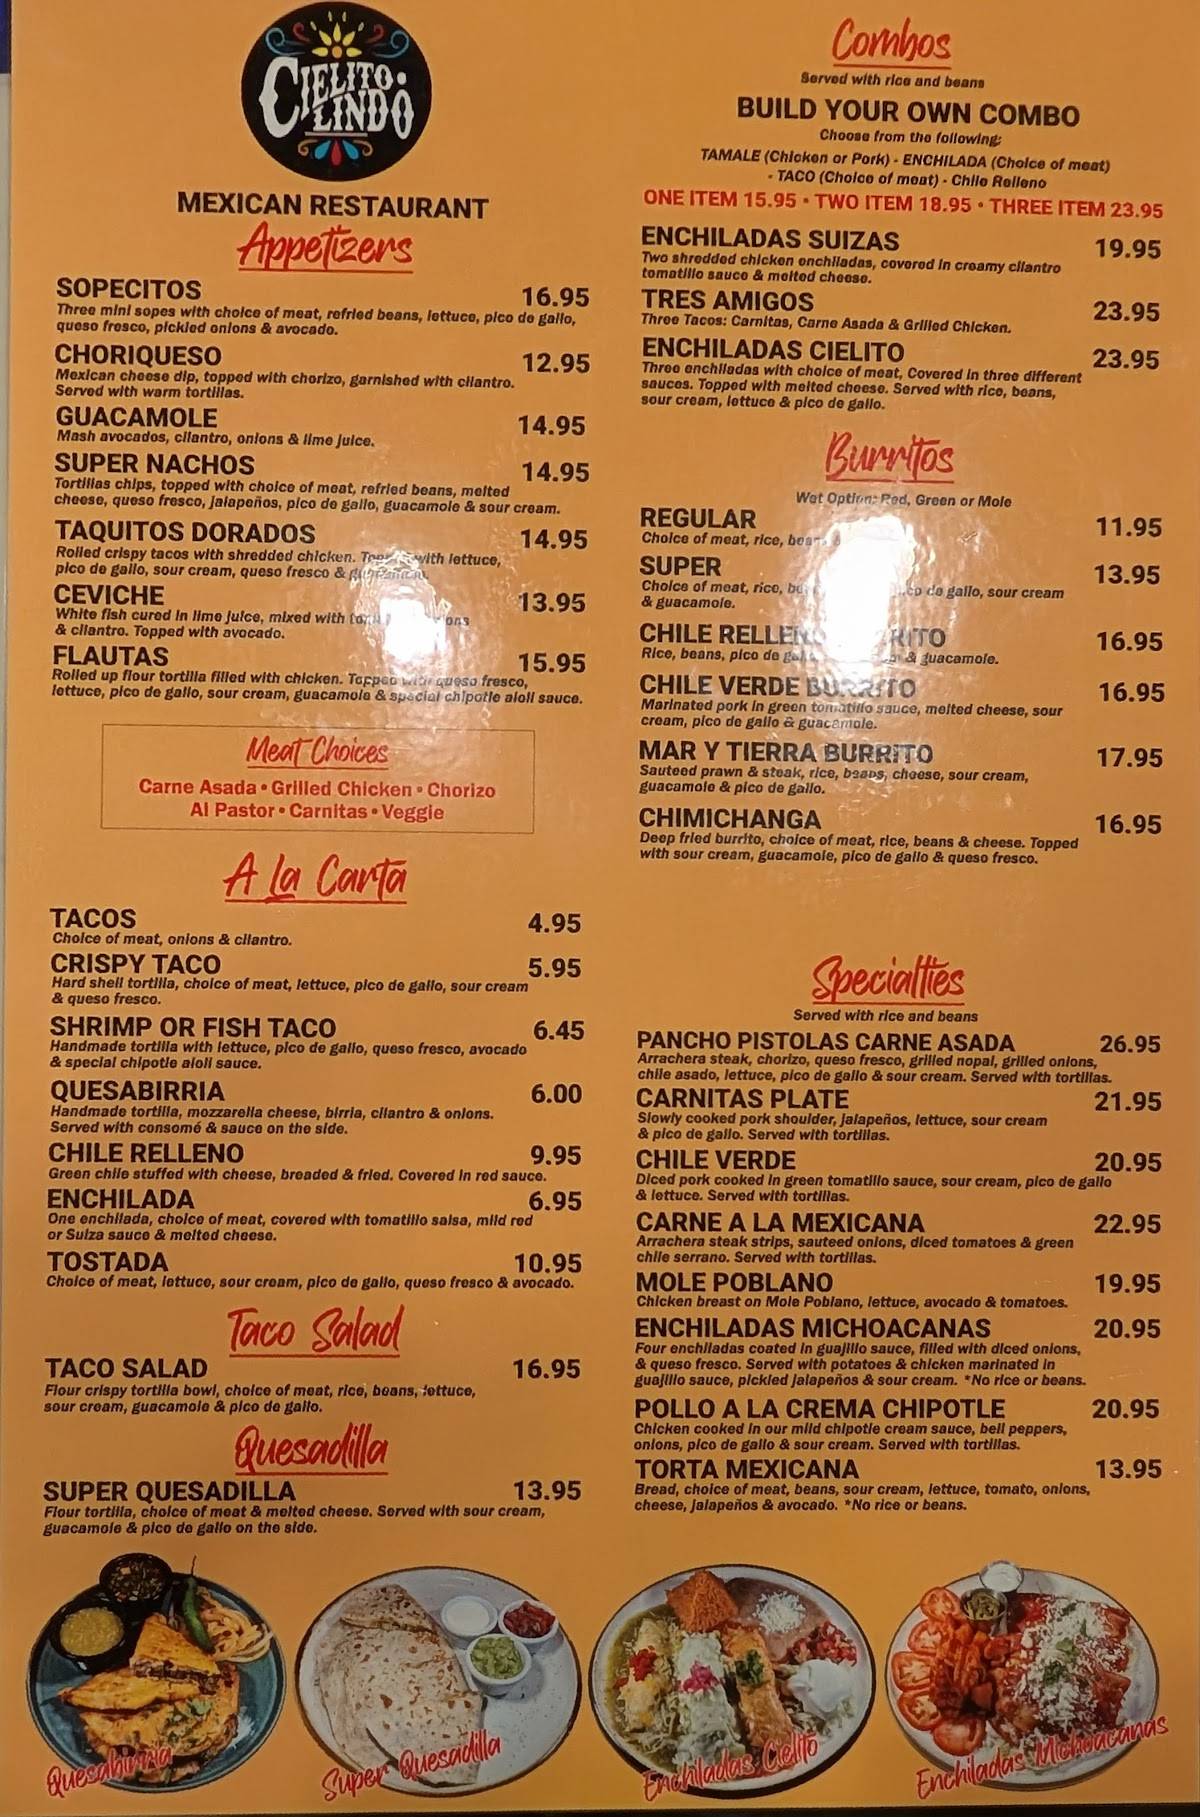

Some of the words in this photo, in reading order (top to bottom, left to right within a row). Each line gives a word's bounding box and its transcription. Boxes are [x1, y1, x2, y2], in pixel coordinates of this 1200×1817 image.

[832, 17, 950, 61] Combos
[258, 57, 394, 138] CIELITO
[312, 88, 414, 140] LINDO
[738, 96, 816, 119] BUILD
[825, 98, 898, 122] YOUR
[908, 101, 970, 124] OWN
[980, 103, 1079, 127] COMBO
[178, 191, 301, 215] MEXICAN
[311, 194, 489, 219] RESTAURANT
[644, 189, 684, 205] ONE
[690, 190, 737, 207] ITEM
[744, 191, 796, 208] 15.95
[815, 193, 858, 209] TWO
[866, 194, 912, 211] ITEM
[920, 196, 971, 213] 18.95
[990, 198, 1053, 215] THREE
[1059, 199, 1105, 217] ITEM
[1111, 201, 1163, 218] 23.95
[237, 220, 412, 270] Appetizers
[642, 225, 801, 249] ENCHILADAS
[809, 229, 899, 251] SUIZAS
[1096, 238, 1160, 259] 19.95
[57, 277, 201, 300] SOPECITOS
[523, 286, 589, 307] 16.95
[642, 288, 705, 309] TRES
[713, 290, 813, 312] AMIGOS
[642, 312, 679, 325] Three
[684, 313, 726, 326] Tacos:
[732, 314, 792, 329] Carnitas,
[798, 316, 838, 328] Carne
[842, 317, 883, 330] Asada
[888, 318, 899, 330] &
[904, 318, 949, 331] Grilled
[953, 320, 1011, 334] Chicken.
[55, 343, 221, 368] CHORIQUESO
[643, 336, 802, 360] ENCHILADAS
[810, 340, 904, 363] CIELITO
[55, 384, 104, 397] Served
[108, 384, 137, 397] with
[143, 388, 180, 397] warm
[186, 386, 243, 399] tortillas.
[57, 405, 217, 428] GUACAMOLE
[55, 452, 138, 473] SUPER
[147, 453, 254, 475] NACHOS
[826, 432, 953, 479] Burritos
[641, 507, 756, 529] REGULAR
[1097, 516, 1161, 538] 11.95
[55, 519, 184, 543] TAQUITOS
[192, 521, 315, 544] DORADOS
[640, 555, 721, 576] SUPER
[54, 584, 164, 606] CEVICHE
[55, 623, 66, 635] &
[71, 623, 128, 636] cilantro.
[134, 624, 184, 639] Topped
[189, 625, 218, 638] with
[223, 627, 284, 639] avocado.
[54, 645, 168, 666] FLAUTAS
[247, 736, 312, 767] Meat
[311, 735, 388, 765] Choices
[1098, 747, 1162, 768] 17.95
[139, 778, 193, 794] Carne
[200, 779, 256, 795] Asada
[272, 780, 331, 796] Grilled
[338, 780, 411, 797] Chicken
[428, 781, 495, 798] Chorizo
[191, 801, 208, 817] Al
[216, 802, 274, 818] Pastor
[290, 802, 367, 819] Carnitas
[382, 803, 444, 823] Veggie
[640, 807, 821, 830] CHIMICHANGA
[223, 852, 258, 896] A
[264, 853, 301, 903] La
[316, 854, 408, 901] Carta
[50, 908, 136, 928] TACOS
[529, 913, 580, 933] 4.95
[51, 953, 145, 974] CRISPY
[152, 954, 220, 974] TACO
[812, 955, 964, 1003] Specialties
[794, 1008, 841, 1021] Served
[845, 1009, 874, 1021] with
[879, 1009, 904, 1021] rice
[908, 1010, 934, 1022] and
[938, 1010, 978, 1022] beans
[50, 1015, 152, 1036] SHRIMP
[160, 1016, 195, 1037] OR
[204, 1017, 260, 1037] FISH
[268, 1017, 336, 1038] TACO
[638, 1030, 731, 1049] PANCHO
[738, 1031, 848, 1051] PISTOLAS
[856, 1032, 931, 1051] CARNE
[938, 1033, 1015, 1052] ASADA
[1101, 1034, 1160, 1053] 26.95
[51, 1079, 225, 1103] QUESABIRRIA
[637, 1087, 763, 1108] CARNITAS
[771, 1088, 849, 1109] PLATE
[1095, 1091, 1161, 1111] 21.95
[51, 1120, 99, 1133] Served
[104, 1120, 133, 1133] with
[138, 1120, 201, 1133] consomé
[206, 1121, 216, 1134] &
[221, 1124, 262, 1134] sauce
[267, 1124, 283, 1134] on
[289, 1122, 311, 1134] the
[315, 1122, 347, 1134] side.
[49, 1142, 123, 1162] CHILE
[131, 1142, 243, 1163] RELLENO
[48, 1188, 194, 1209] ENCHILADA
[637, 1211, 721, 1232] CARNE
[728, 1212, 746, 1232] A
[754, 1212, 785, 1232] LA
[793, 1212, 925, 1233] MEXICANA
[1094, 1213, 1161, 1234] 22.95
[47, 1251, 168, 1272] TOSTADA
[515, 1253, 581, 1273] 10.95
[637, 1250, 669, 1262] chile
[674, 1253, 729, 1263] serrano.
[735, 1250, 781, 1263] Served
[786, 1251, 814, 1263] with
[820, 1251, 876, 1263] tortillas.
[228, 1308, 295, 1350] Taco
[312, 1304, 405, 1352] Salad
[636, 1317, 794, 1338] ENCHILADAS
[803, 1317, 990, 1338] MICHOACANAS
[45, 1357, 114, 1378] TACO
[123, 1357, 207, 1378] SALAD
[636, 1398, 715, 1419] POLLO
[722, 1399, 740, 1419] A
[748, 1398, 779, 1419] LA
[787, 1398, 875, 1419] CREMA
[883, 1398, 1005, 1419] CHIPOTLE
[235, 1422, 388, 1472] Quesadilla
[635, 1459, 718, 1479] TORTA
[727, 1458, 859, 1479] MEXICANA
[43, 1481, 128, 1501] SUPER
[136, 1480, 296, 1504] QUESADILLA
[635, 1498, 686, 1512] cheese,
[690, 1498, 758, 1513] jalapeños
[762, 1498, 773, 1510] &
[777, 1498, 837, 1510] avocado.
[875, 1498, 900, 1510] rice
[905, 1501, 918, 1510] or
[923, 1498, 966, 1510] beans.
[322, 1762, 390, 1801] Super
[400, 1729, 500, 1780] Quesadilla
[642, 1749, 754, 1801] Enchiladas
[762, 1730, 818, 1771] Cielito
[916, 1748, 1026, 1799] Enchiladas
[1035, 1715, 1169, 1766] Michoacanas
